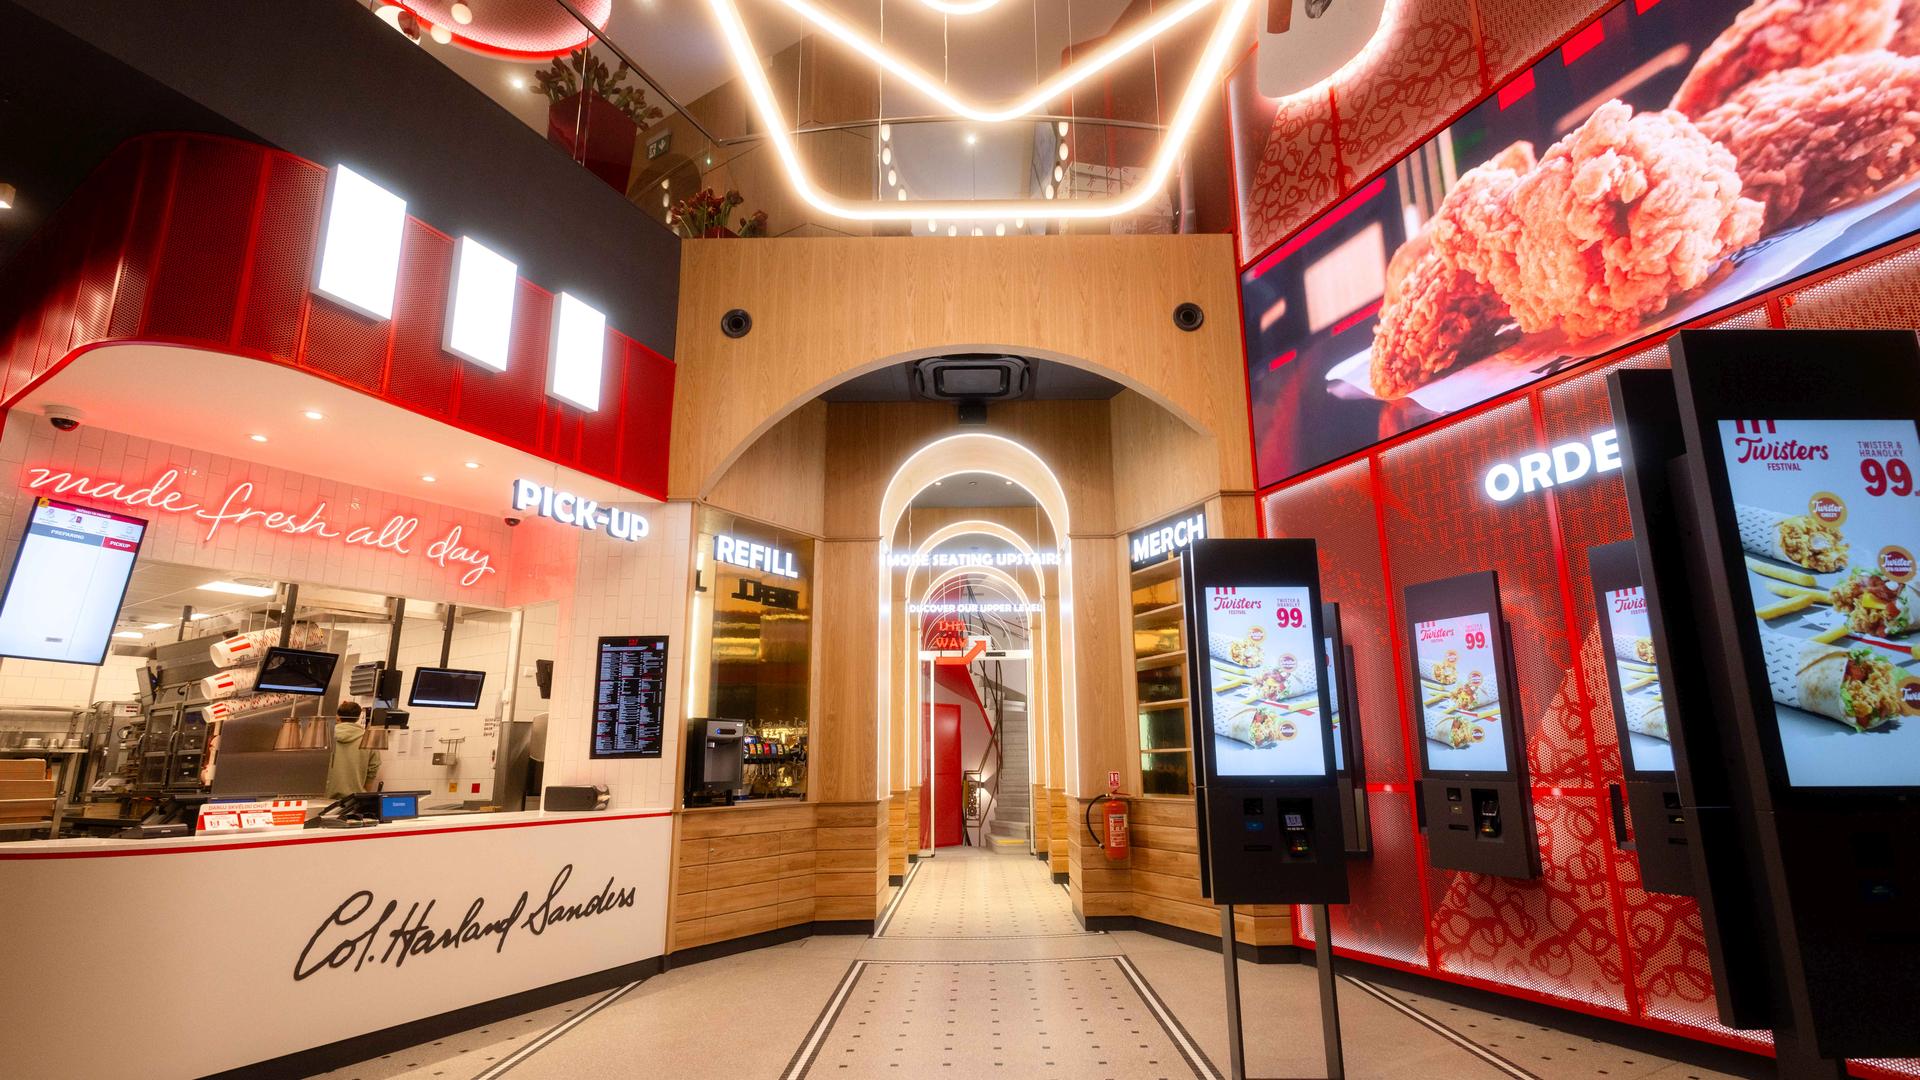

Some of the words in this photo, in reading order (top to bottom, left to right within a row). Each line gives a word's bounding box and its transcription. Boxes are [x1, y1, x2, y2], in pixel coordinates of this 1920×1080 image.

[1735, 437, 1829, 464] Twisters
[1857, 441, 1893, 449] TWISTER
[1896, 441, 1902, 449] &
[1859, 450, 1904, 458] HRANOLKY
[1485, 429, 1622, 501] ORDE
[1767, 463, 1802, 471] FESTIVAL
[1860, 458, 1913, 497] 99
[513, 478, 649, 542] PICK-UP
[29, 467, 199, 513] made
[197, 482, 340, 543] fresh
[346, 515, 419, 554] all
[426, 526, 495, 587] day
[1133, 513, 1204, 563] MERCH
[713, 534, 798, 579] REFILL
[887, 553, 930, 567] MORE
[932, 553, 994, 567] SEATING
[996, 552, 1061, 566] UPSTAIRS
[908, 604, 956, 613] DISCOVER
[957, 604, 979, 613] OUR
[980, 604, 1012, 613] UPPER
[1013, 603, 1042, 613] LEVEL
[1214, 596, 1262, 611] Twisters
[1276, 607, 1303, 628] 99
[936, 637, 968, 648] WAY
[1421, 628, 1454, 641] Twisters
[1465, 631, 1486, 650] 99
[293, 890, 397, 981] Col.
[381, 892, 528, 968] Harland
[521, 864, 636, 935] Sanders
